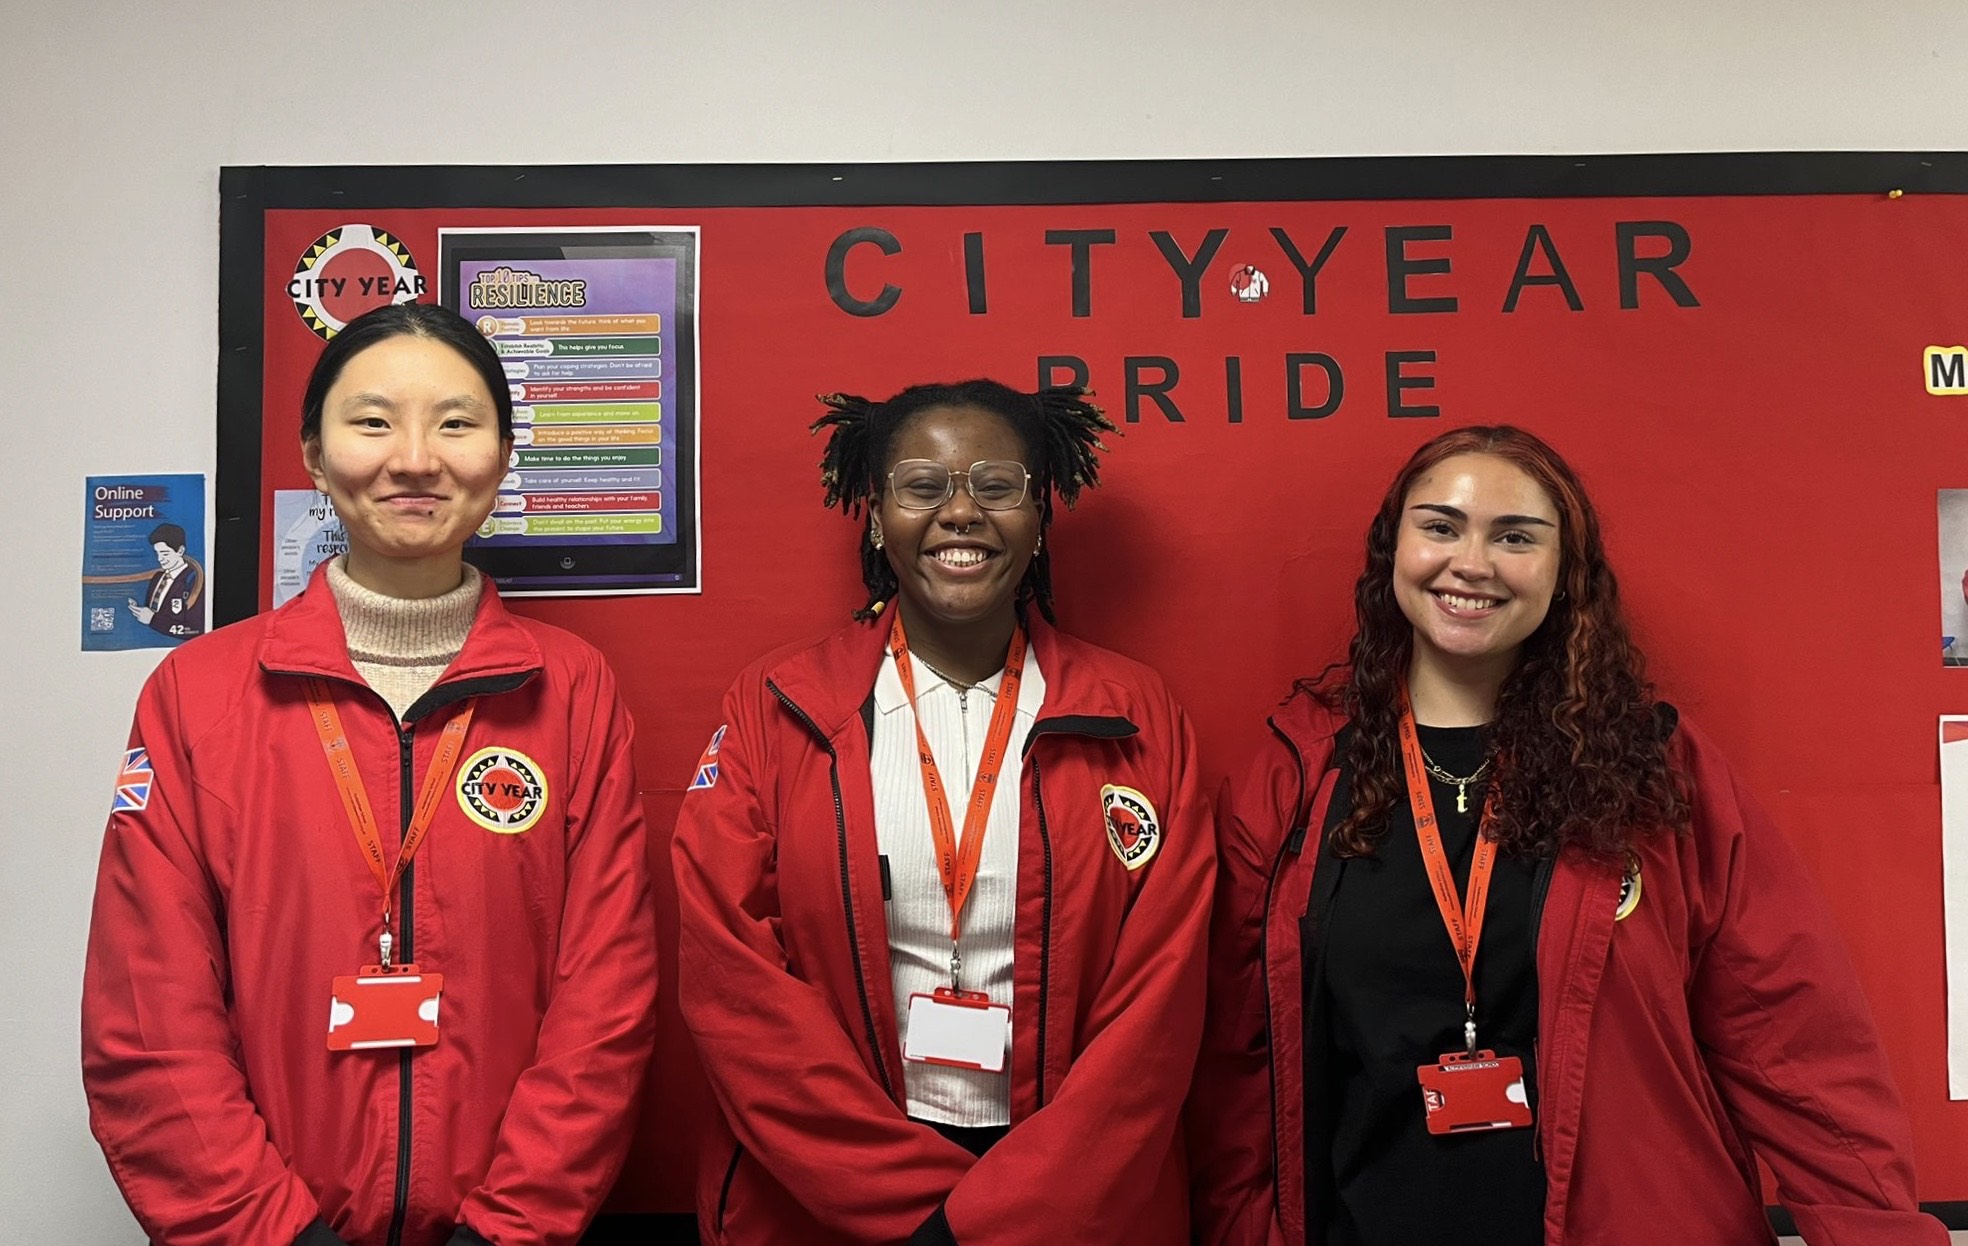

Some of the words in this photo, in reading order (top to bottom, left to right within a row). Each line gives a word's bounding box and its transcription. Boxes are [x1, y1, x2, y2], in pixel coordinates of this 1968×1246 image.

[825, 226, 1229, 317] CITY
[1269, 220, 1700, 314] YEAR
[287, 278, 346, 298] CITY
[358, 275, 428, 296] YEAR
[481, 274, 495, 283] TOP
[512, 274, 529, 282] TIPS
[471, 282, 584, 306] RESILIENCE
[1038, 350, 1440, 424] PRIDE
[95, 486, 144, 500] Online
[95, 505, 154, 521] Support
[309, 507, 326, 521] my
[322, 530, 345, 542] This
[169, 624, 185, 635] 42
[1005, 682, 1014, 699] STAFF
[319, 713, 332, 732] STAFF
[336, 757, 350, 779] STAFF
[461, 782, 496, 796] CITY
[501, 783, 543, 800] YEAR
[929, 772, 937, 792] STAFF
[978, 789, 987, 808] STAFF
[1121, 822, 1157, 836] YEAR
[367, 839, 381, 864] STAFF
[1479, 849, 1488, 871] STAFF
[944, 851, 952, 876] STAFF
[959, 873, 967, 897] STAFF
